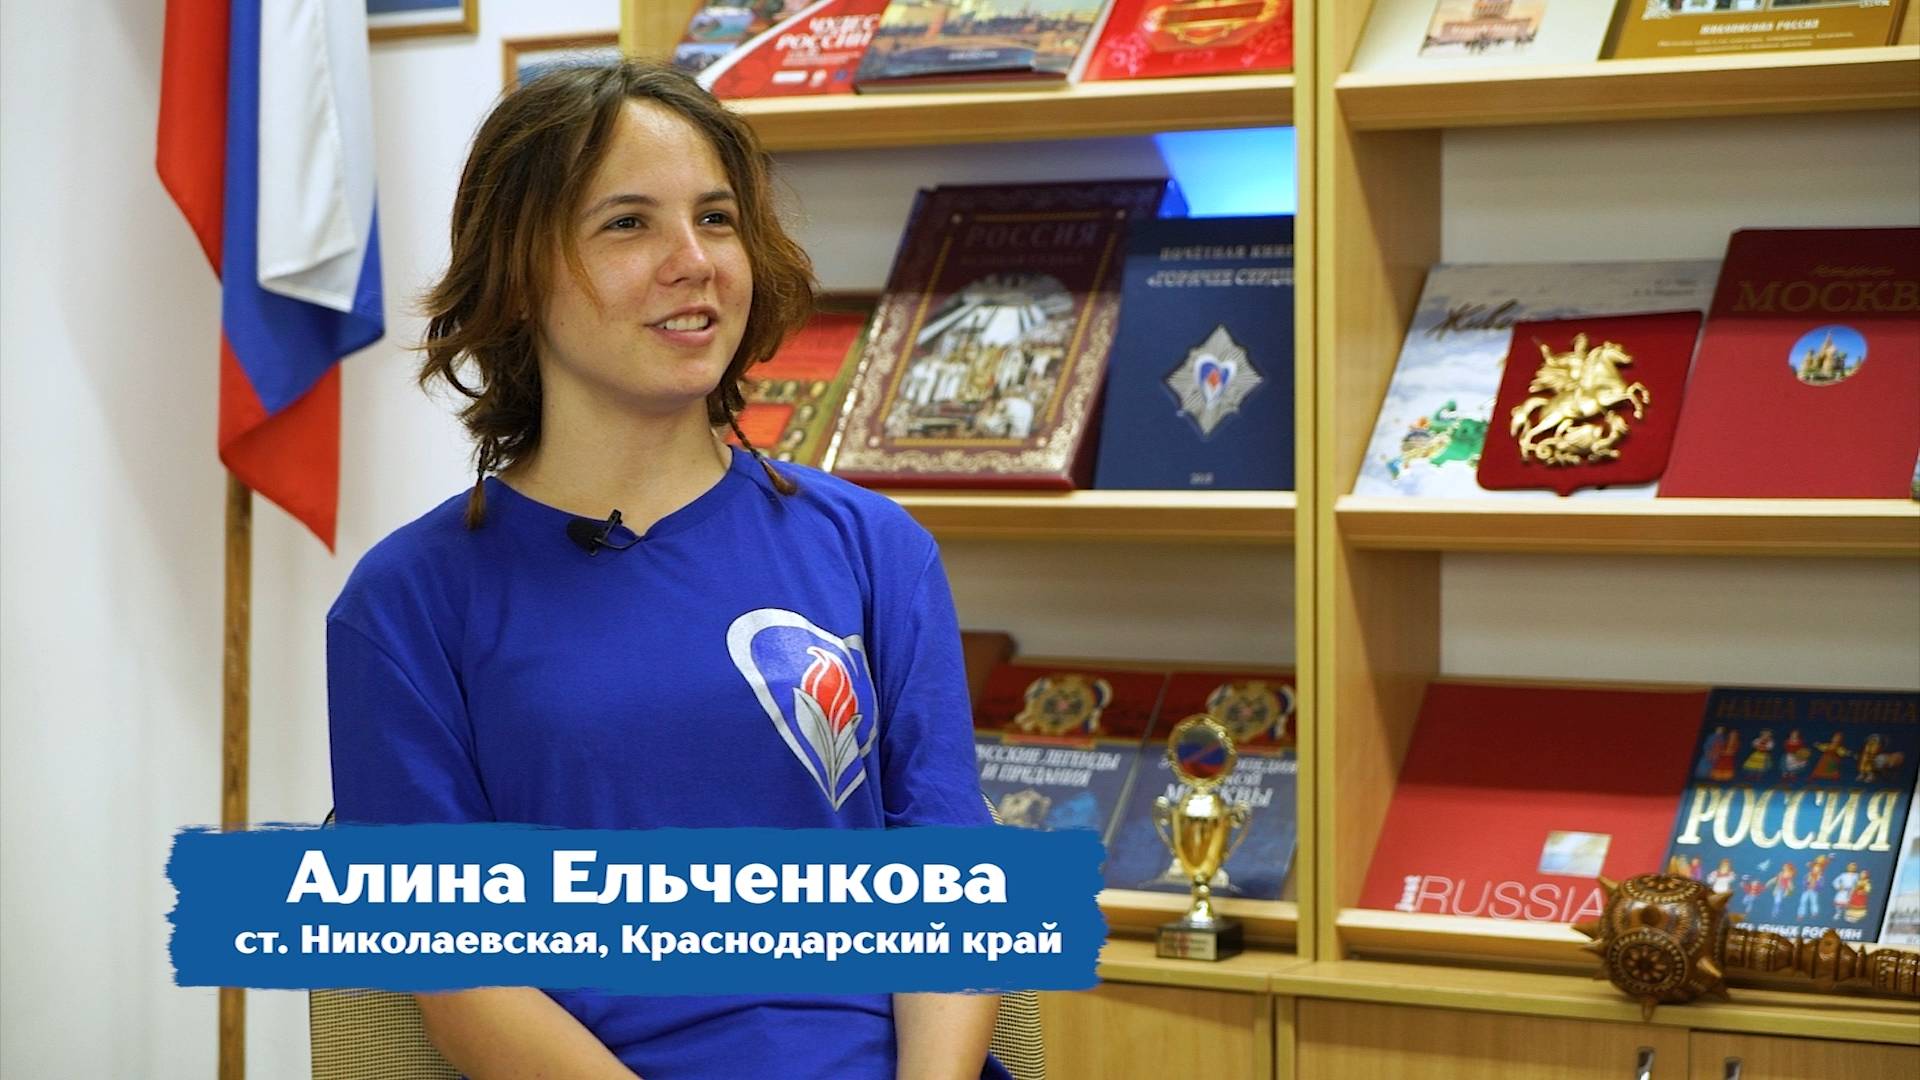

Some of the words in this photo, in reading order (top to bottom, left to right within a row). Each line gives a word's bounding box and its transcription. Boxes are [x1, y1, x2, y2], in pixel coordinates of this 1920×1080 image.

[964, 222, 1099, 248] РОССИЯ
[1732, 281, 1920, 313] МОСКВ
[974, 744, 1044, 764] УССКИЕ
[1677, 784, 1900, 851] РОССИЯ
[1416, 875, 1605, 924] RUSSIA
